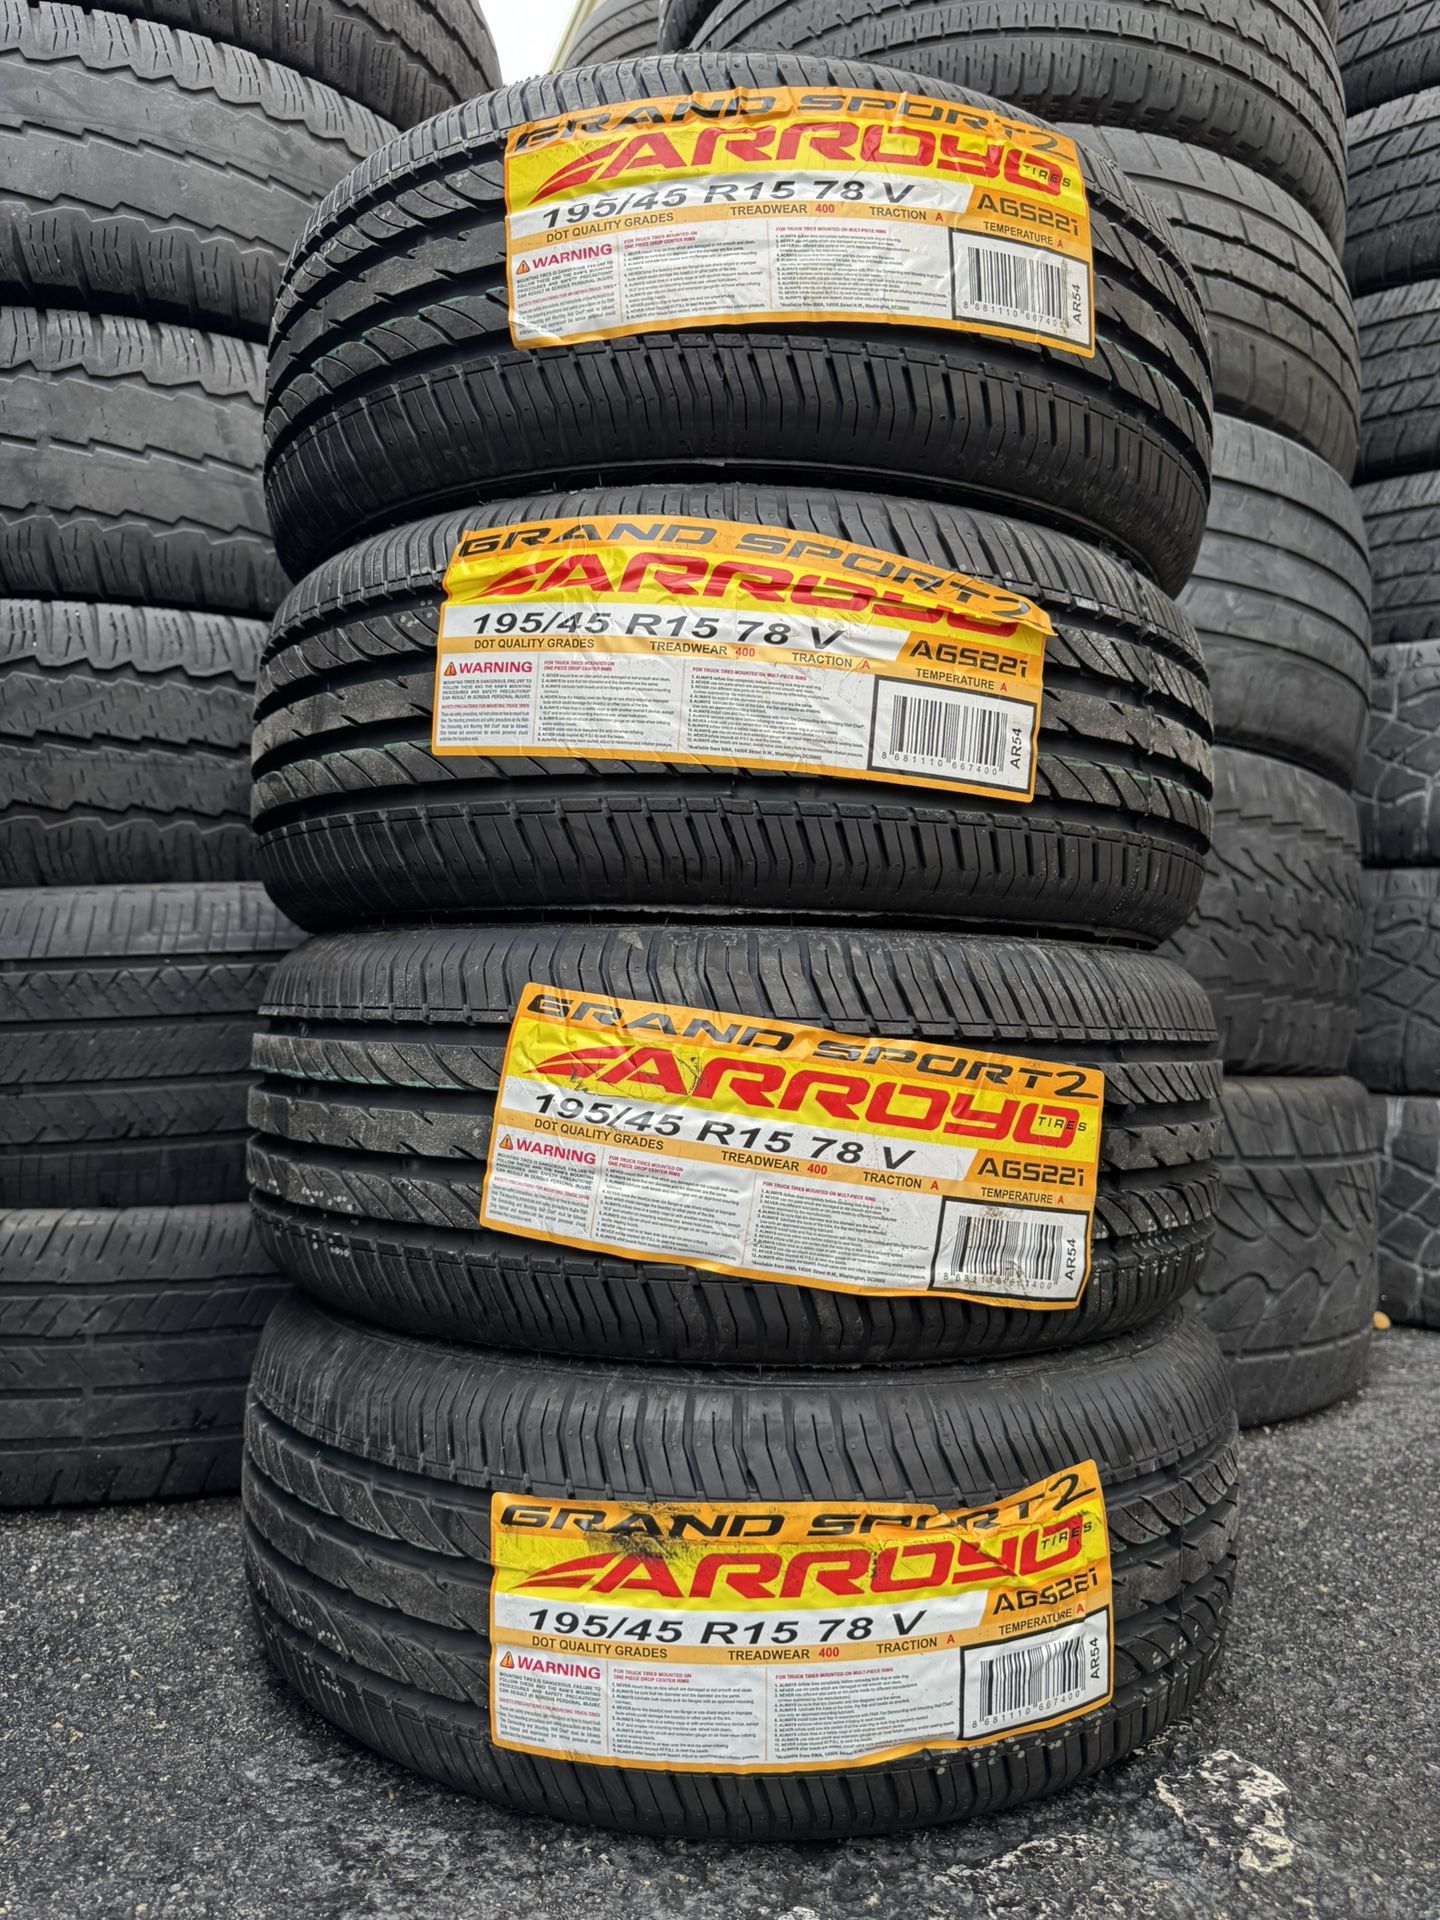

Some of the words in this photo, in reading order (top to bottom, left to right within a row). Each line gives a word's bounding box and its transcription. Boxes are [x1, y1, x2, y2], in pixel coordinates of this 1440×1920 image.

[514, 94, 776, 152] GRAND
[798, 94, 1074, 162] SPORT2
[596, 120, 1064, 196] ARROYO
[1020, 162, 1072, 188] TIRES
[542, 186, 688, 228] 195/45
[704, 180, 796, 204] R15
[812, 180, 866, 202] 78
[882, 182, 916, 204] V
[730, 204, 808, 216] TREADWEAR
[814, 204, 836, 214] 400
[869, 206, 926, 221] TRACTION
[934, 212, 944, 222] A
[546, 228, 568, 244] DOT
[572, 220, 622, 238] QUALITY
[624, 212, 674, 228] GRADES
[984, 220, 1054, 246] TEMPERATURE
[1056, 238, 1064, 250] A
[532, 242, 613, 270] WARNING
[962, 300, 969, 310] 8
[974, 302, 1018, 318] 681110
[1072, 284, 1082, 325] AR54
[458, 522, 718, 557] GRAND
[736, 532, 1040, 626] SPORT2
[472, 611, 612, 634] 195/45
[624, 613, 720, 639] R15
[736, 619, 792, 646] 78
[812, 626, 846, 650] V
[474, 639, 495, 649] DOT
[498, 638, 545, 649] QUALITY
[546, 638, 595, 649] GRADES
[458, 660, 533, 674] WARNING
[650, 640, 728, 656] TREADWEAR
[735, 646, 756, 657] 400
[792, 652, 852, 668] TRACTION
[862, 660, 871, 670] A
[916, 667, 996, 690] TEMPERATURE
[1000, 682, 1008, 692] A
[881, 751, 888, 760] 8
[894, 753, 944, 768] 681110
[951, 760, 998, 776] 667400
[1010, 726, 1023, 770] AR54
[526, 994, 796, 1052] GRAND
[812, 1040, 1099, 1100] SPORT2
[596, 1046, 1080, 1149] ARROYO
[534, 1118, 558, 1132] DOT
[560, 1122, 612, 1142] QUALITY
[613, 1132, 665, 1151] GRADES
[535, 1093, 684, 1138] 195/45
[697, 1119, 794, 1154] R15
[810, 1136, 865, 1164] 78
[882, 1146, 916, 1170] V
[1038, 1116, 1088, 1132] TIRES
[516, 1138, 596, 1166] WARNING
[720, 1150, 800, 1172] TREADWEAR
[806, 1163, 828, 1176] 400
[863, 1171, 922, 1189] TRACTION
[930, 1180, 939, 1190] A
[980, 1186, 1053, 1204] TEMPERATURE
[1057, 1195, 1064, 1205] A
[1064, 1238, 1077, 1281] AR54
[944, 1272, 949, 1281] 8
[500, 1504, 786, 1538] GRAND
[1040, 1521, 1092, 1550] TIRES
[588, 1514, 1084, 1598] ARROYO
[528, 1608, 684, 1644] 195/45
[700, 1620, 800, 1646] R15
[819, 1616, 874, 1643] 78
[892, 1609, 927, 1636] V
[998, 1608, 1073, 1636] TEMPERATURE
[1076, 1603, 1085, 1614] A
[532, 1635, 556, 1648] DOT
[559, 1638, 612, 1655] QUALITY
[614, 1645, 668, 1659] GRADES
[728, 1649, 810, 1661] TREADWEAR
[818, 1647, 840, 1658] 400
[876, 1637, 938, 1654] TRACTION
[946, 1634, 955, 1644] A
[1090, 1637, 1100, 1680] AR54
[517, 1655, 601, 1680] WARNING
[972, 1720, 978, 1729] 8
[984, 1707, 1031, 1726] 681110
[1038, 1690, 1080, 1710] 667400
